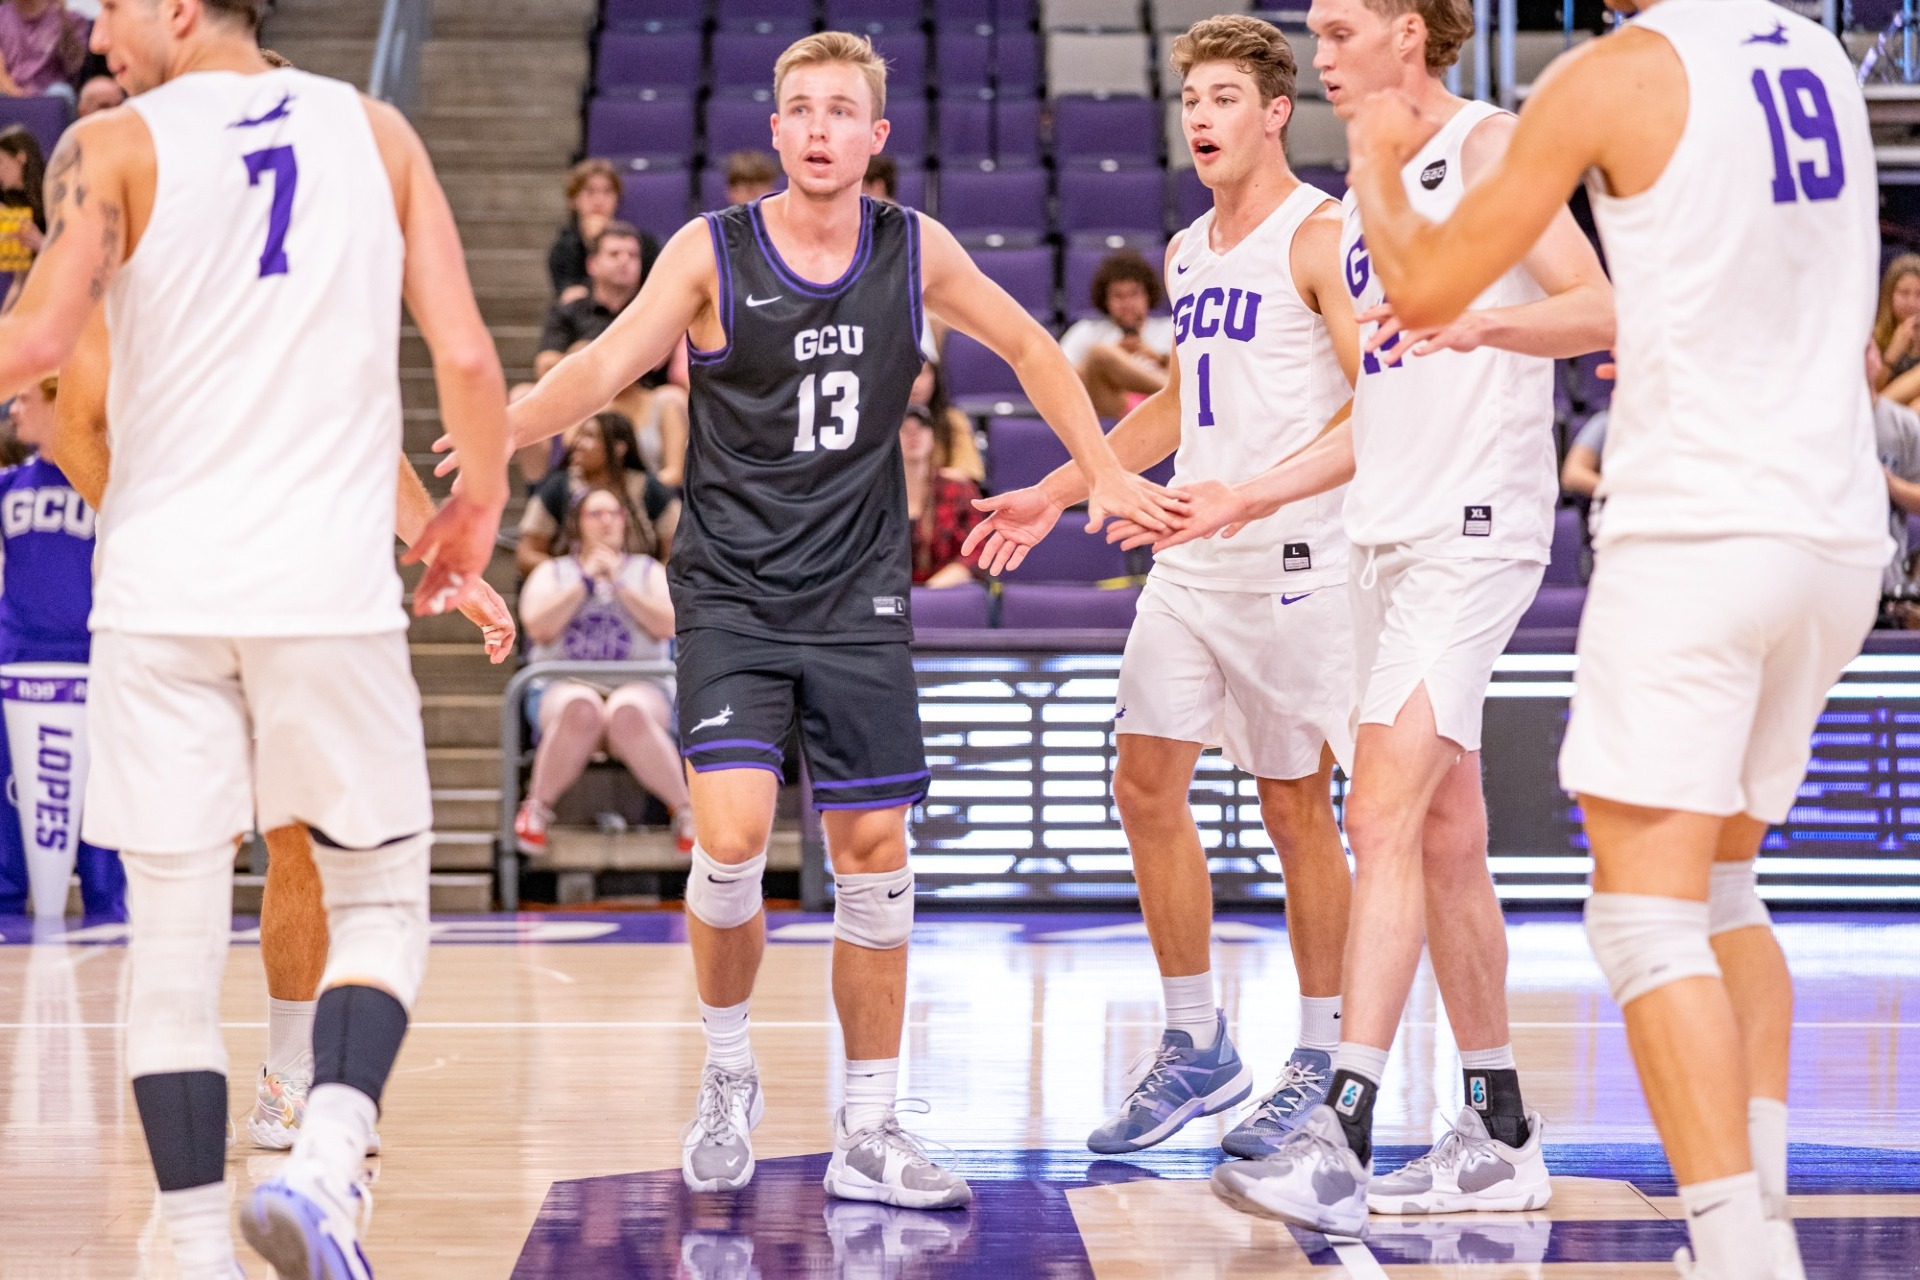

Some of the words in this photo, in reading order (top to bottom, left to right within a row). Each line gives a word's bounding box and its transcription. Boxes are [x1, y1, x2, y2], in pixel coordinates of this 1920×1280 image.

[1751, 68, 1845, 204] 19
[242, 144, 298, 279] 7
[794, 324, 864, 361] GCU
[1172, 287, 1262, 347] GCU
[793, 370, 860, 452] 13
[1197, 353, 1215, 427] 1
[2, 486, 95, 540] GCU
[1470, 508, 1487, 519] XL
[1292, 546, 1300, 555] L
[36, 725, 72, 850] LOPES
